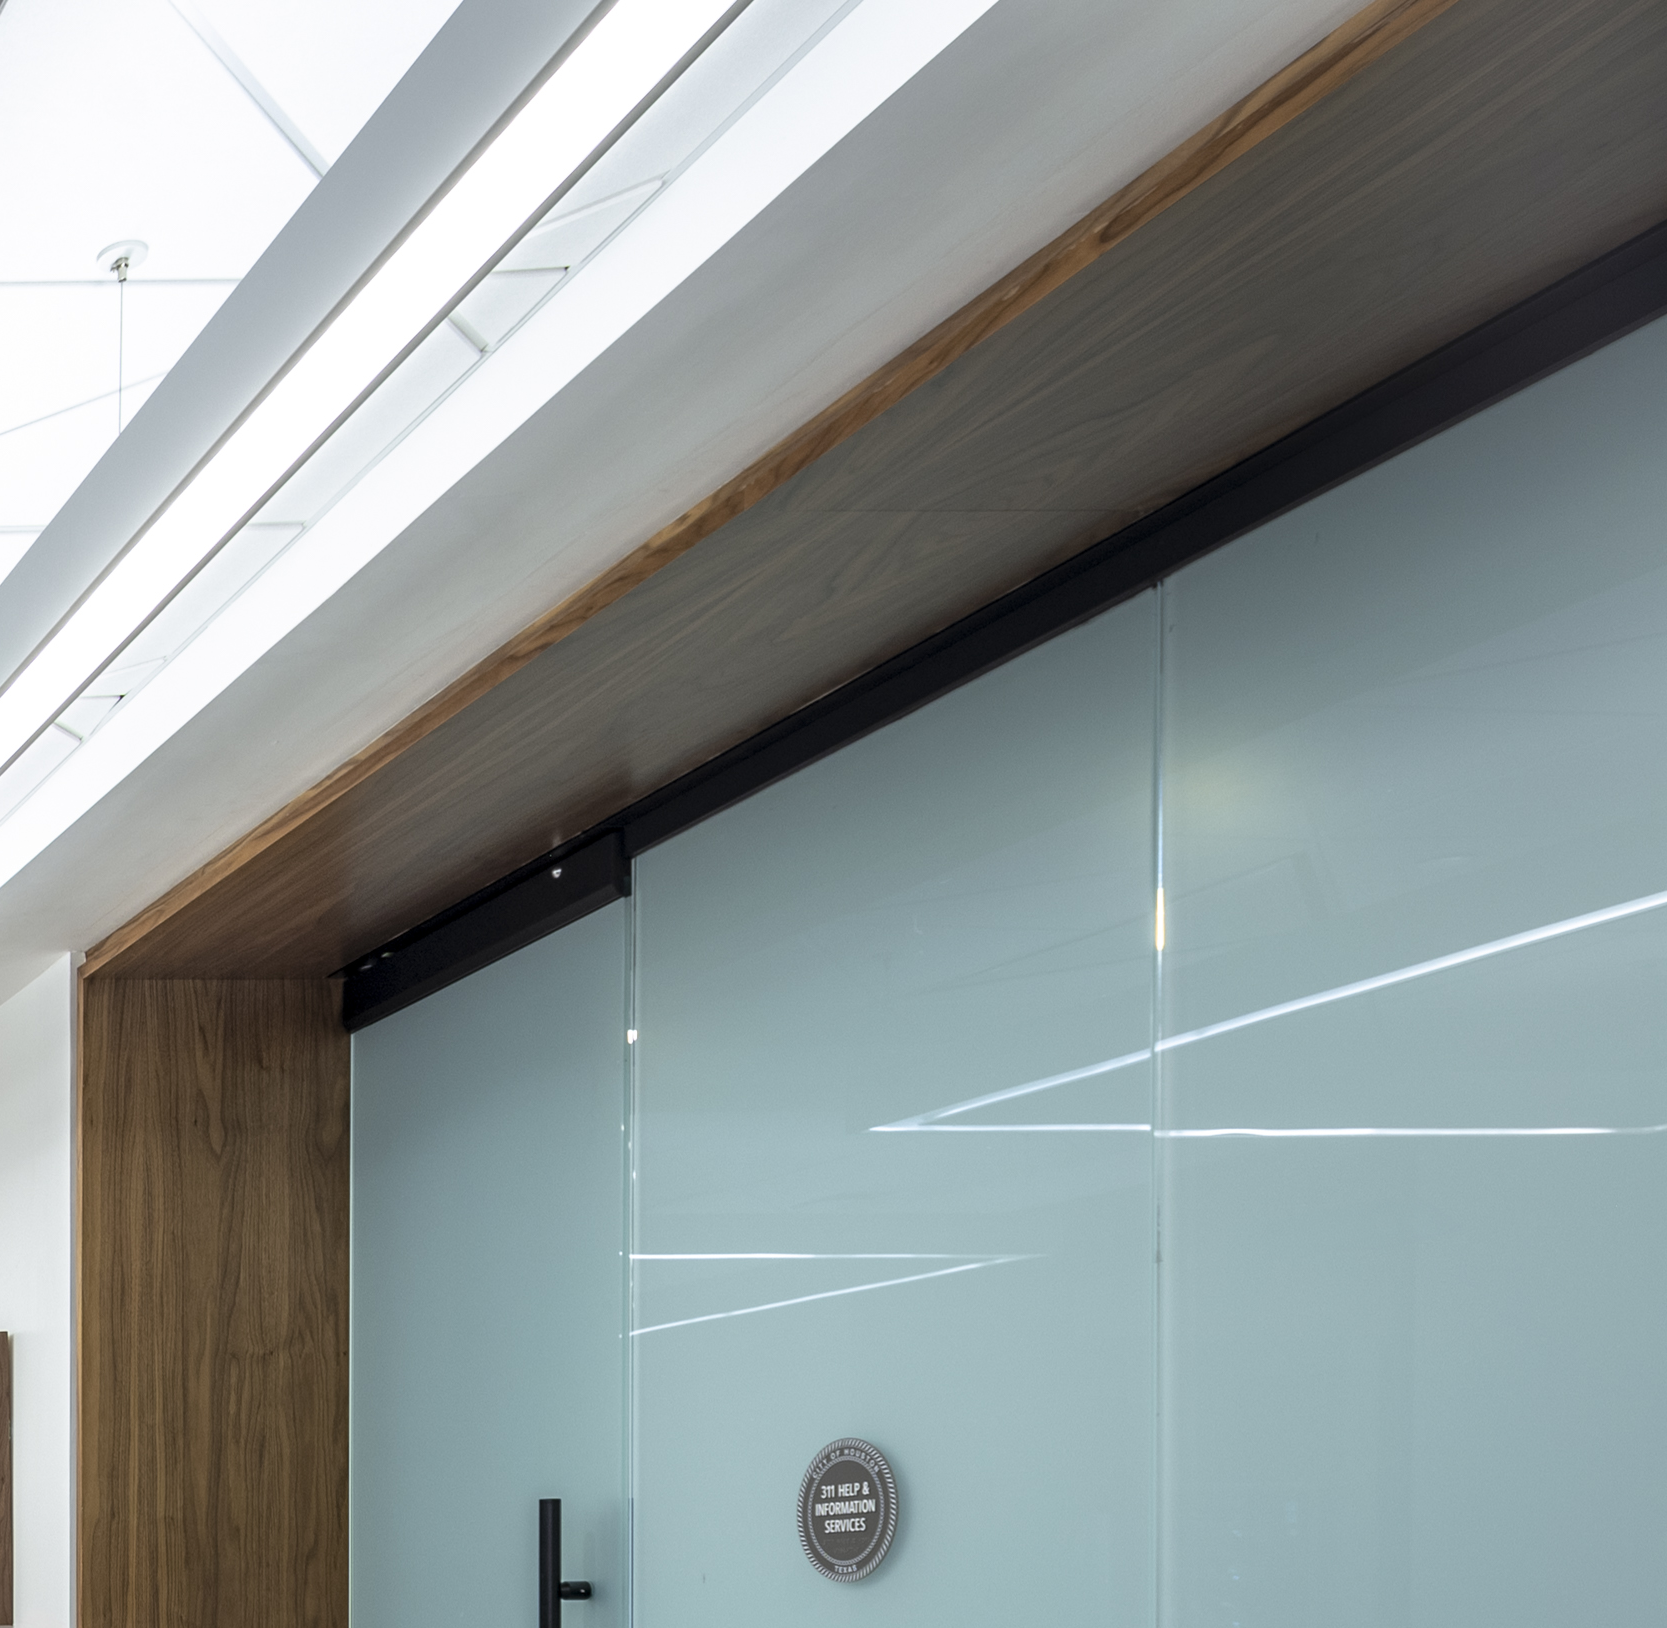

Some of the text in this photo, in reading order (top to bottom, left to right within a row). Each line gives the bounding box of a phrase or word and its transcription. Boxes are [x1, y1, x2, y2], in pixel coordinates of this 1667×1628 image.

[812, 1448, 880, 1479] CITY OF HOUSTON
[820, 1481, 870, 1499] 311 HELP &
[815, 1499, 876, 1517] INFORMATION
[824, 1517, 866, 1534] SERVICES
[834, 1565, 857, 1574] TEXAS
